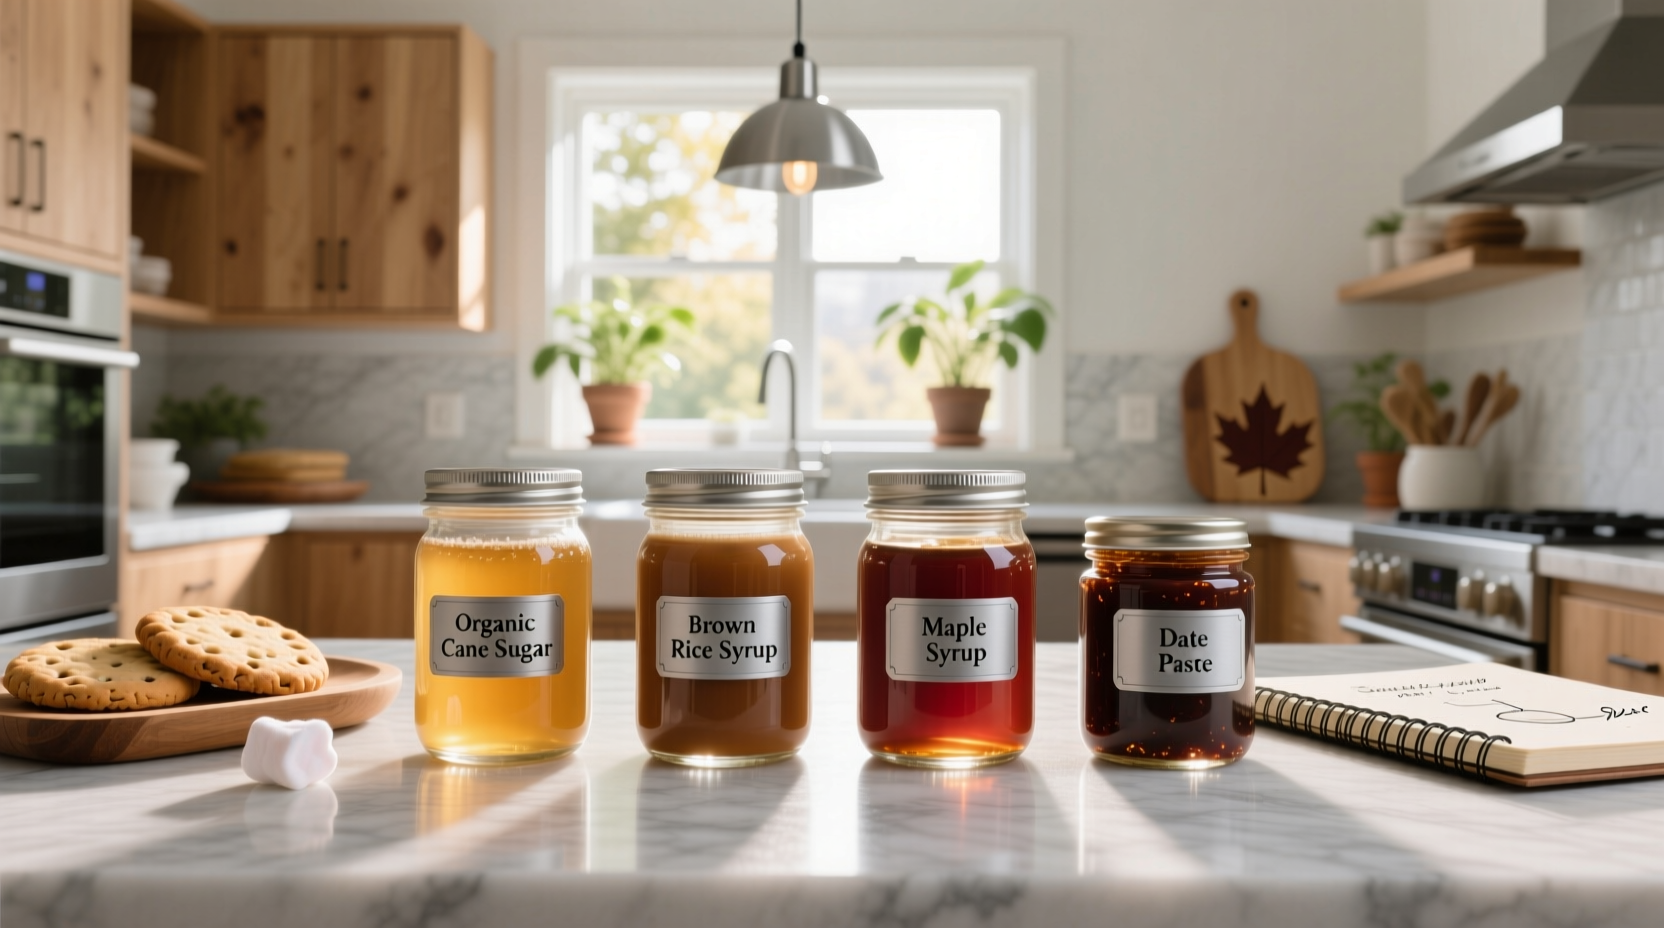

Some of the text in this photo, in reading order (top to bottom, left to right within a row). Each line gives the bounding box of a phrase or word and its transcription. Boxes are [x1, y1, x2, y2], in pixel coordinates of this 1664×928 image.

[455, 612, 535, 637] Organic
[688, 614, 755, 634] Brown
[921, 615, 987, 642] Maple
[441, 637, 553, 663] Cane Sugar
[1159, 627, 1208, 648] Date
[671, 638, 778, 664] Rice Syrup
[926, 642, 987, 667] Syrup
[1158, 653, 1213, 673] Paste
